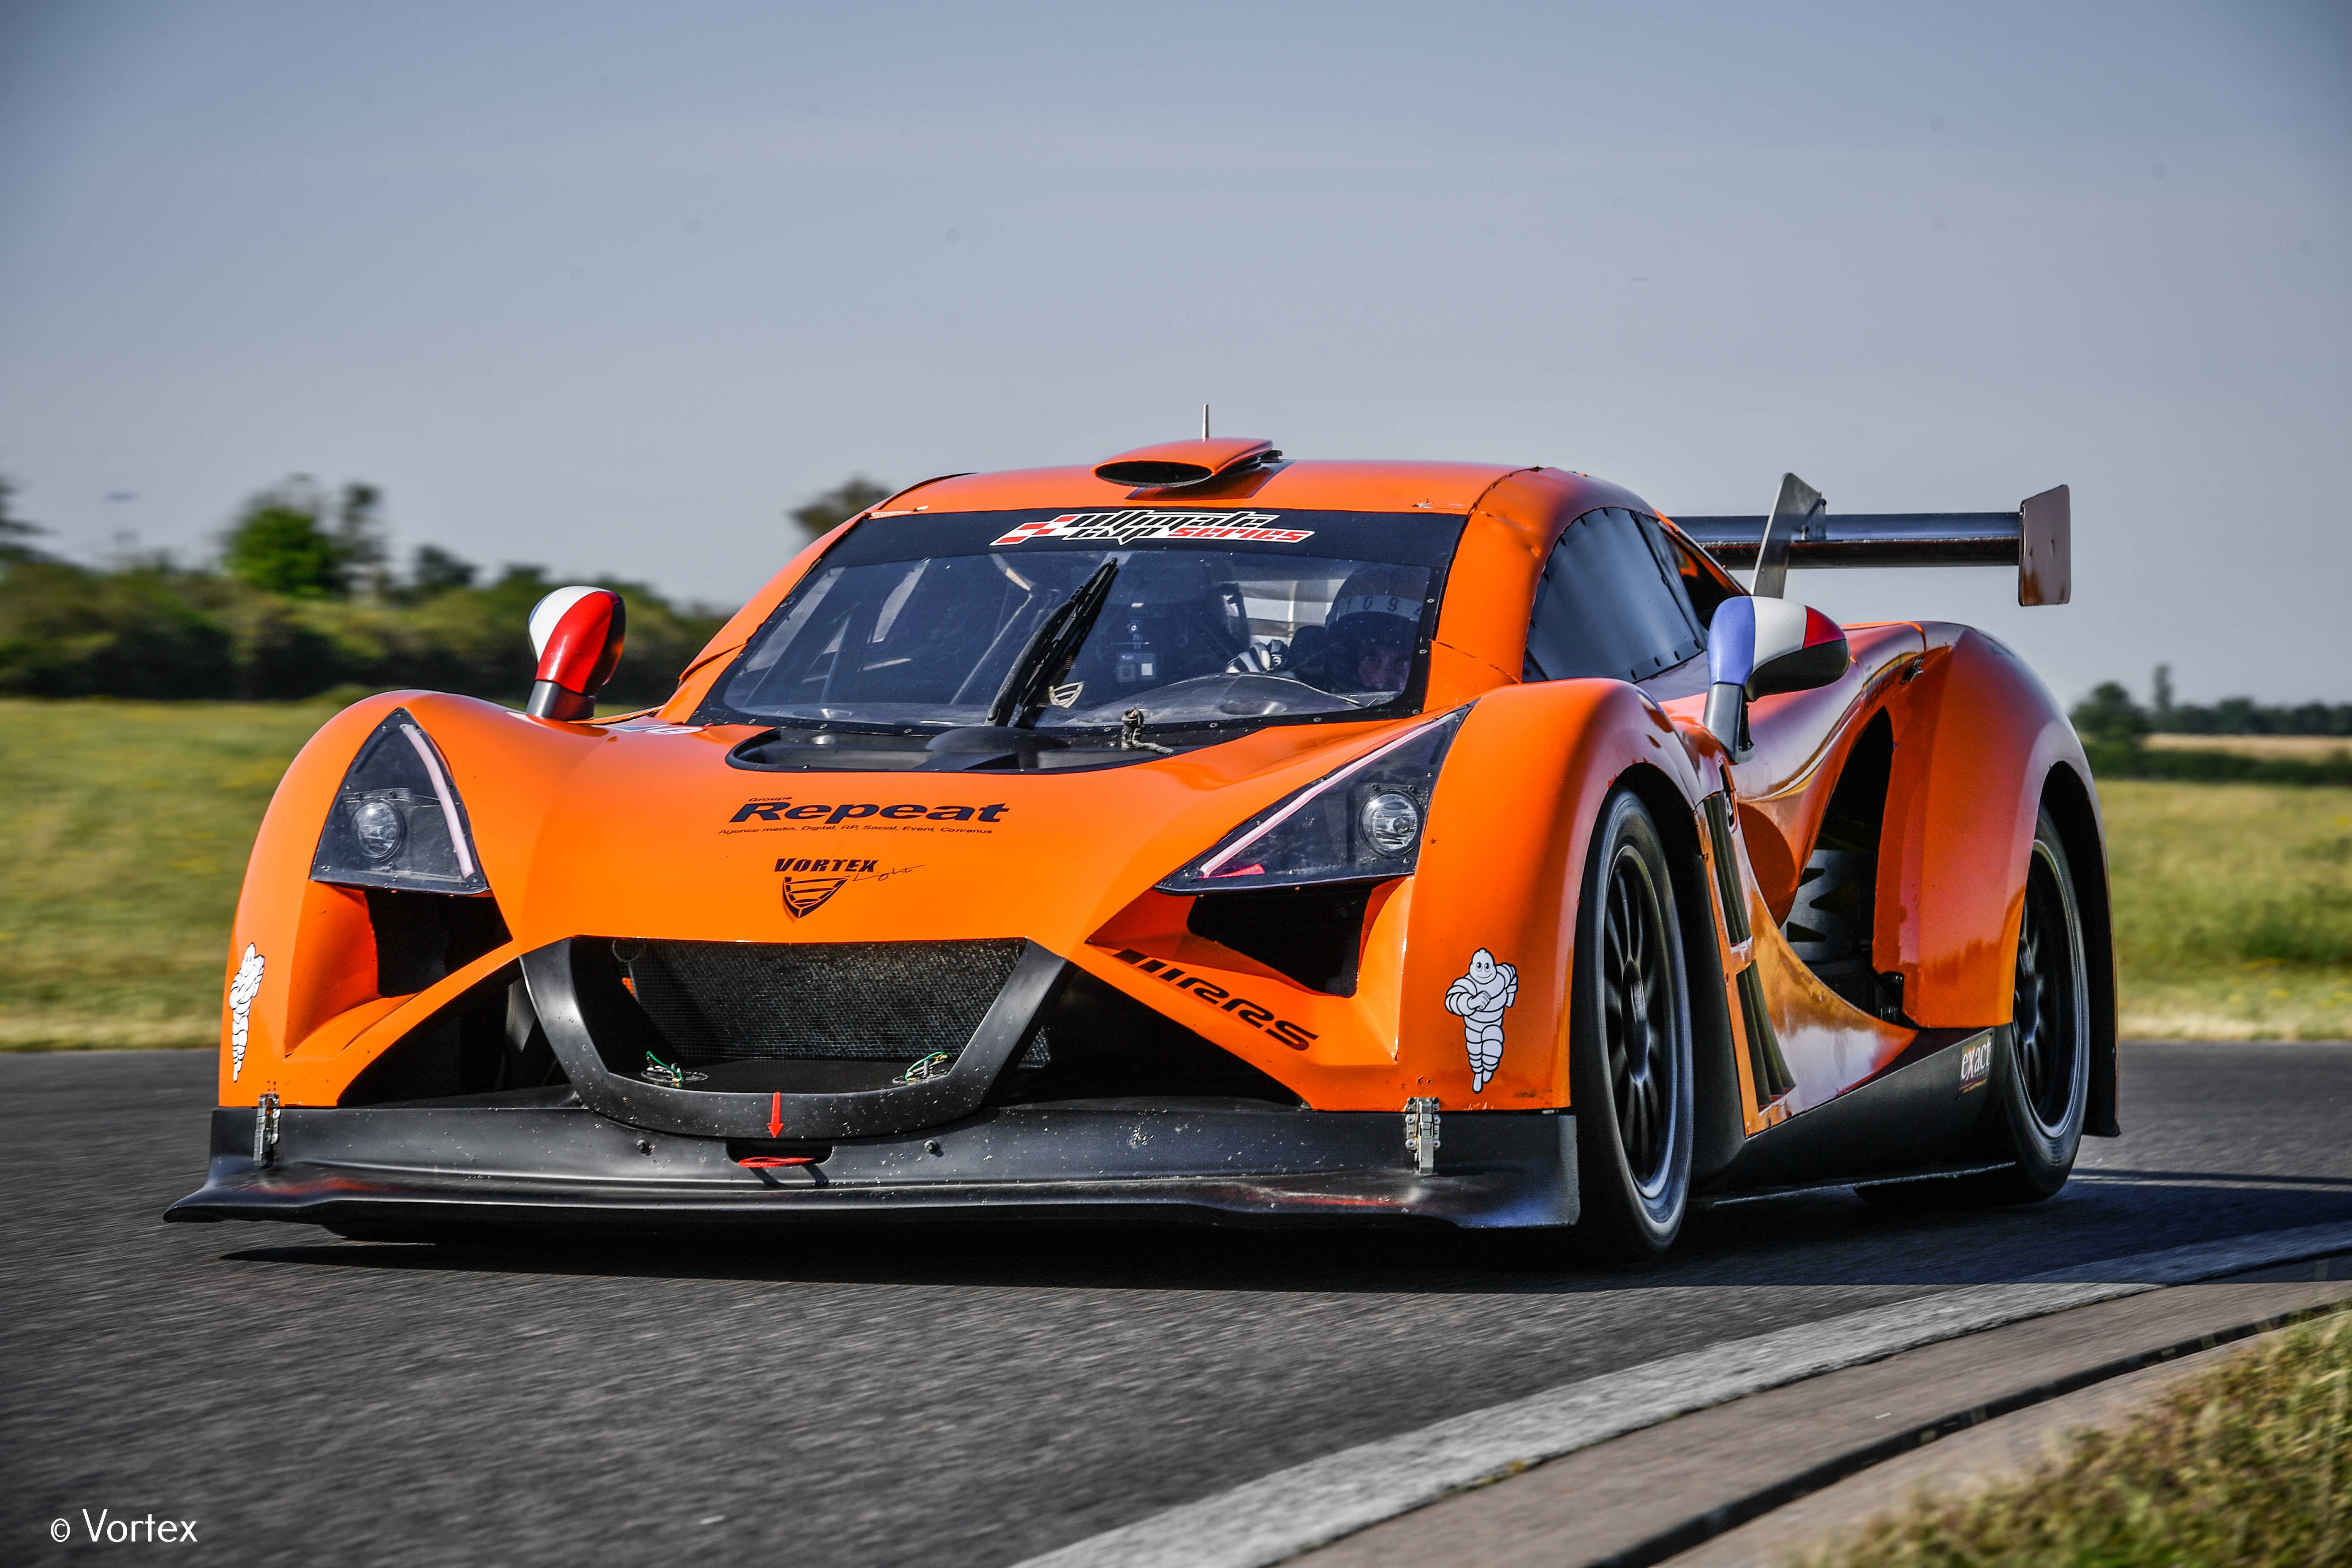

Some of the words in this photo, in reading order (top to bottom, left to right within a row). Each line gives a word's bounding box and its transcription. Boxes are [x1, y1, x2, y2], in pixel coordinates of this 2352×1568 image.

[1167, 527, 1310, 541] series
[729, 802, 1010, 824] Repeat
[774, 858, 879, 872] VORTEX
[1960, 1037, 1992, 1081] exact
